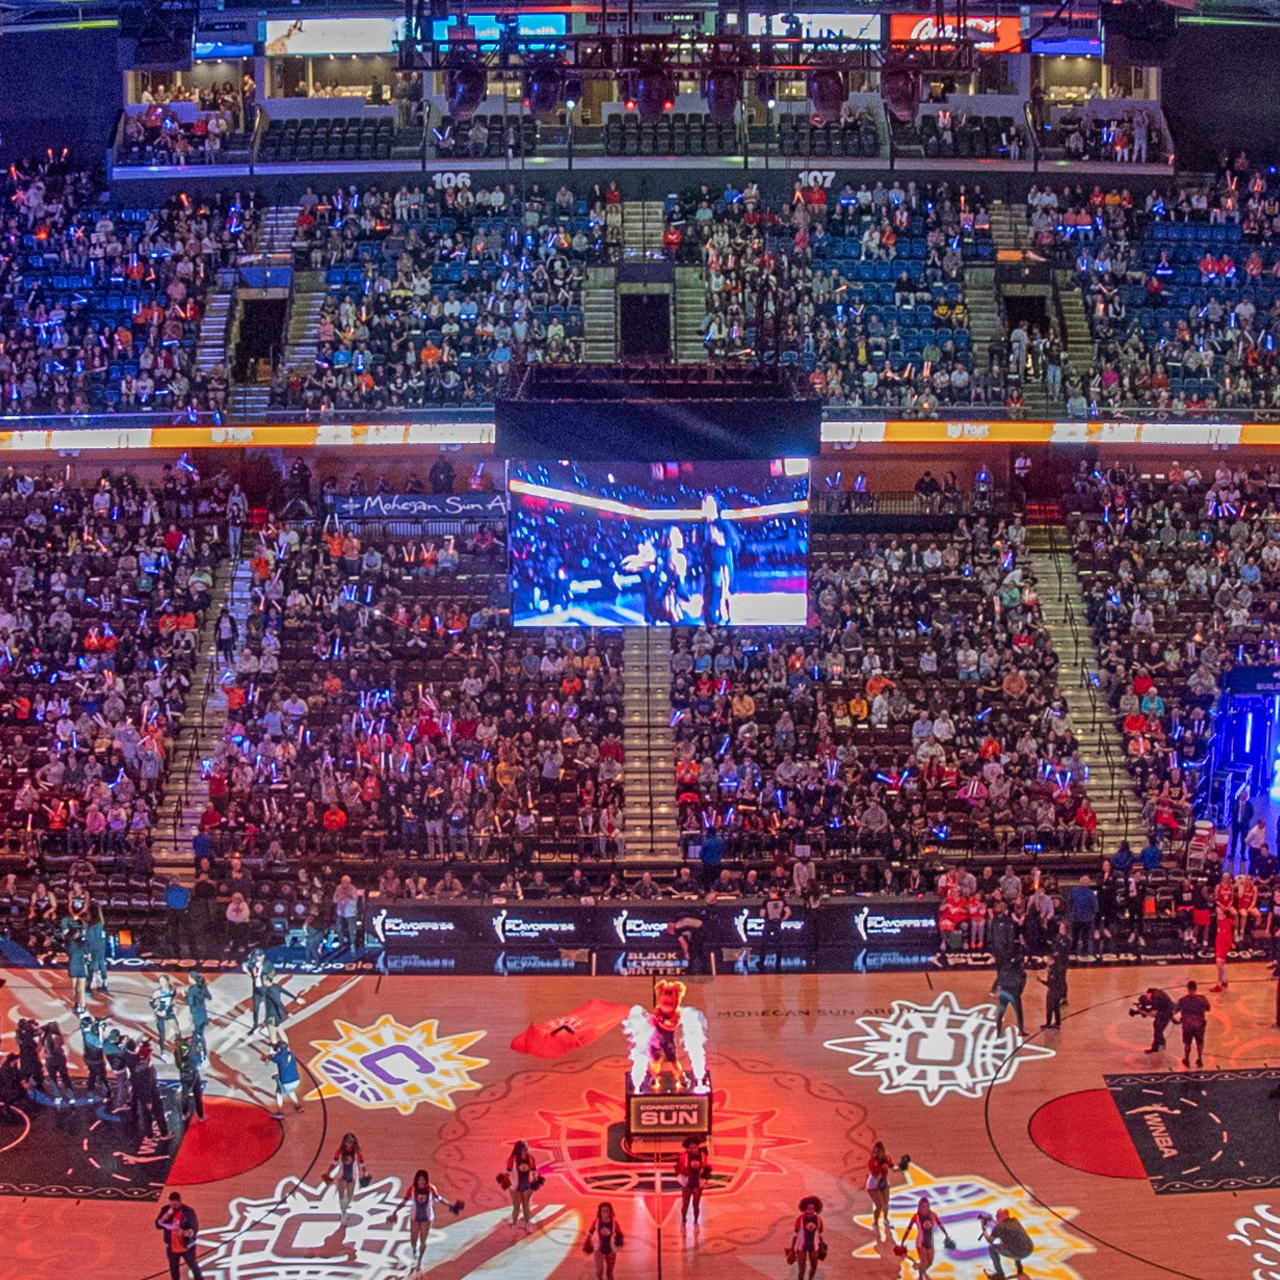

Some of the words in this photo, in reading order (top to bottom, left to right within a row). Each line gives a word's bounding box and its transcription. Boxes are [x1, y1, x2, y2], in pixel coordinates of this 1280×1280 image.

[431, 172, 471, 190] 106
[797, 171, 834, 188] 107
[363, 495, 441, 514] Mohegan
[445, 496, 482, 514] Sun
[717, 1007, 812, 1018] MOHEGAN
[817, 1007, 857, 1017] SUN
[639, 1110, 698, 1126] SUN
[1143, 1112, 1179, 1159] WNBA
